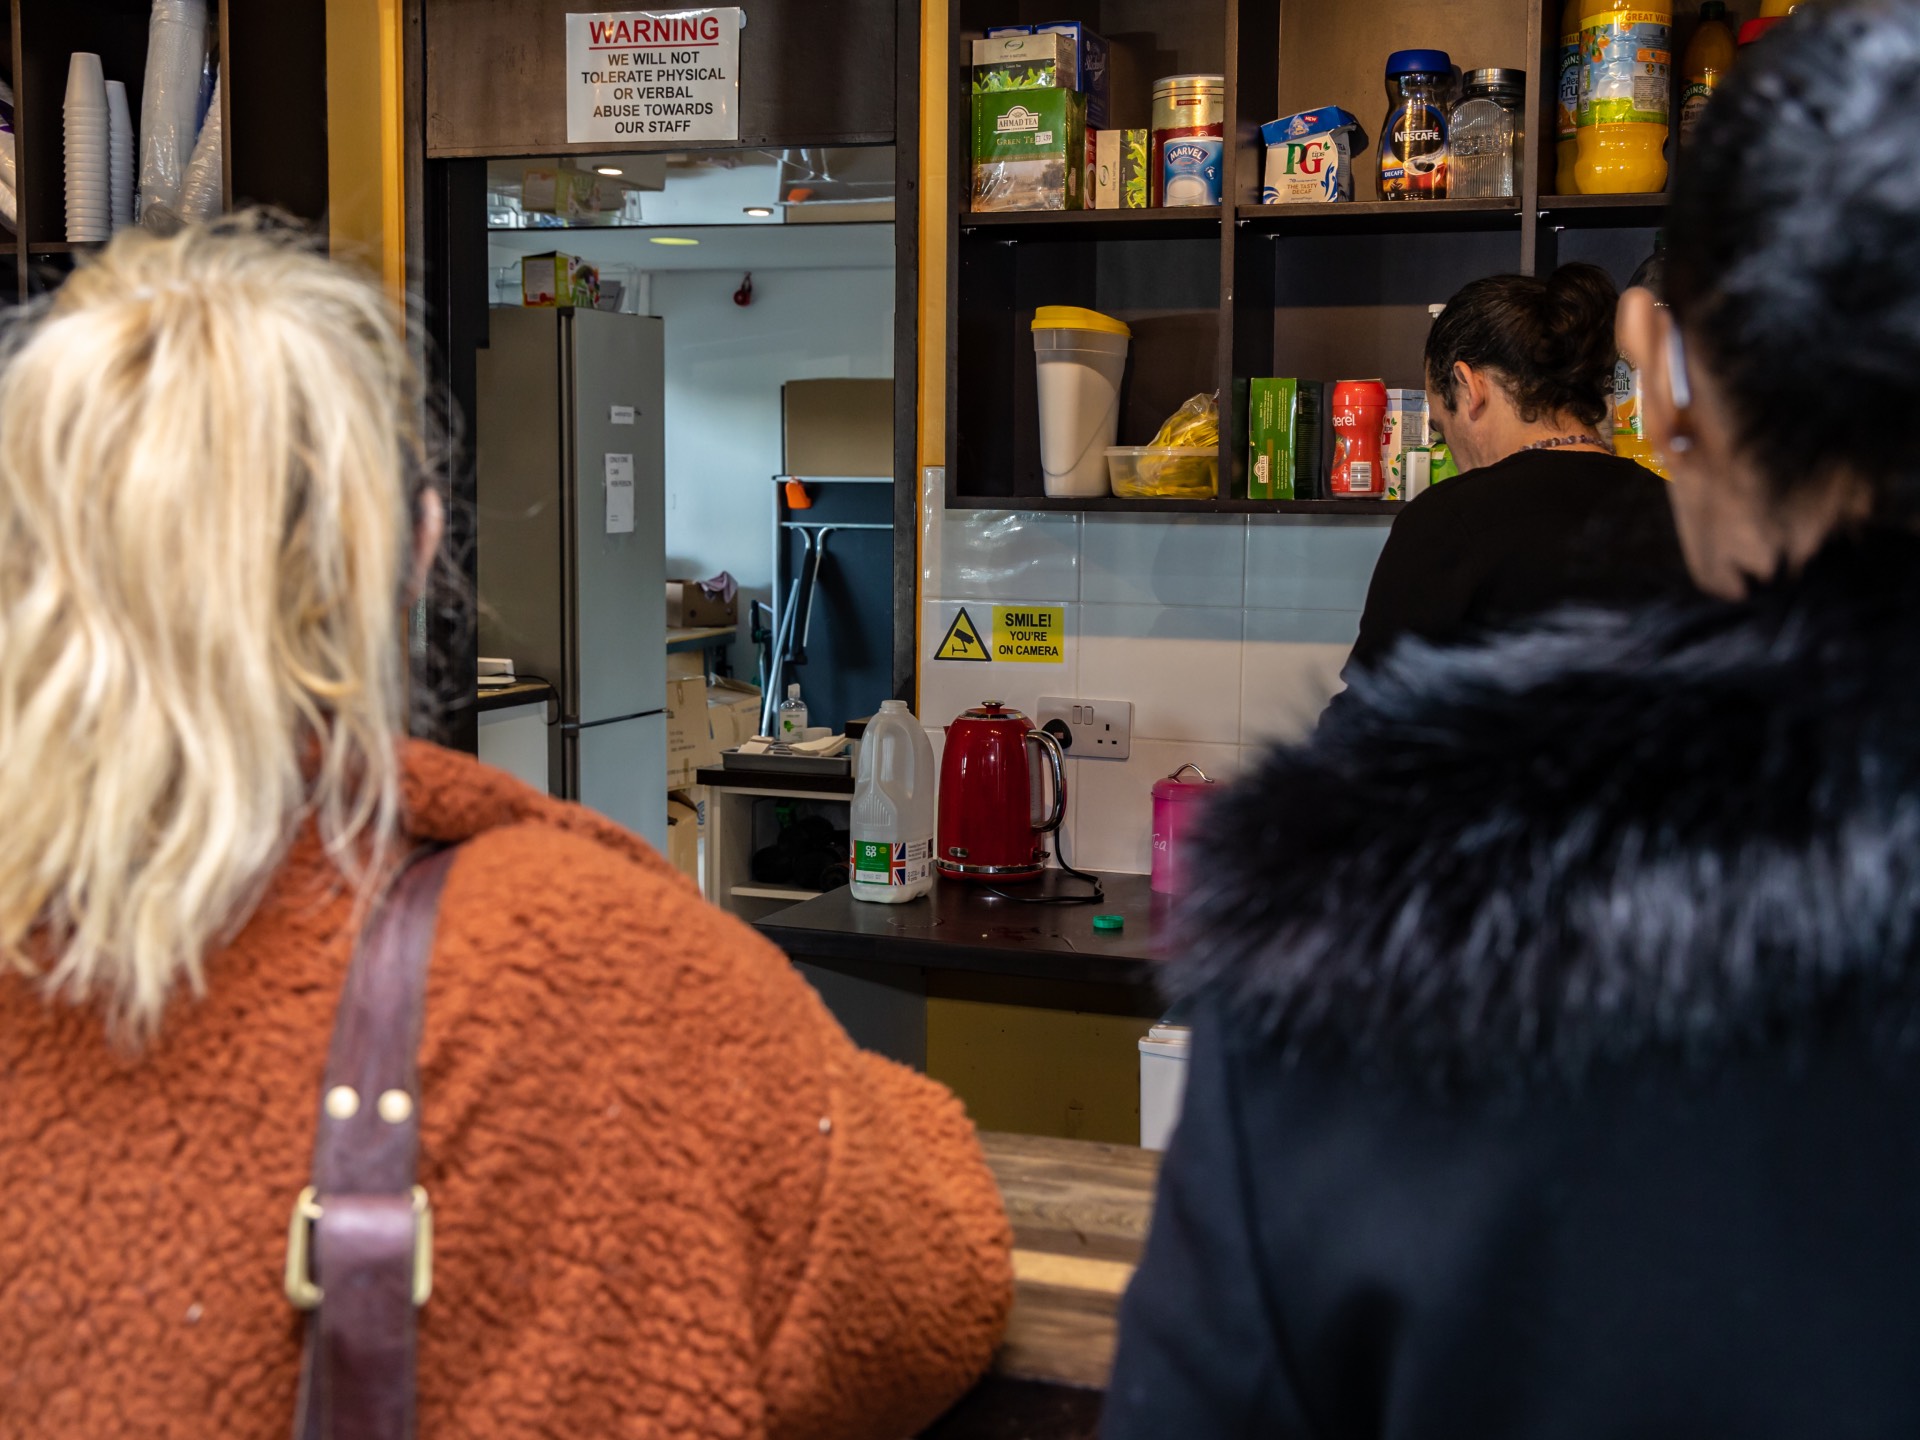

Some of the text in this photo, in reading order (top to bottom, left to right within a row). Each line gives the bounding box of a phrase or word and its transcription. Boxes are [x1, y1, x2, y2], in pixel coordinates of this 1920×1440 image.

[1626, 13, 1653, 22] GREAT
[589, 17, 719, 44] WARNING
[608, 51, 700, 66] WE WILL NOT
[581, 68, 726, 84] TOLERATE PHYSICAL
[1566, 77, 1579, 86] Rea
[613, 86, 693, 100] OR VERBAL
[1560, 84, 1578, 98] Fru
[593, 102, 713, 118] ABUSE TOWARDS
[615, 120, 691, 134] OUR STAFF
[998, 118, 1037, 127] AHMAD TEA
[996, 138, 1021, 146] GREEN
[1023, 136, 1035, 144] TE
[1170, 146, 1203, 161] MARVEL
[1283, 142, 1325, 175] PG tips
[1615, 377, 1630, 391] ruit
[1332, 413, 1355, 427] derel
[1005, 613, 1051, 627] SMILE!
[1010, 631, 1047, 641] YOU'RE
[999, 645, 1059, 656] ON CAMERA
[1152, 833, 1167, 851] Tea
